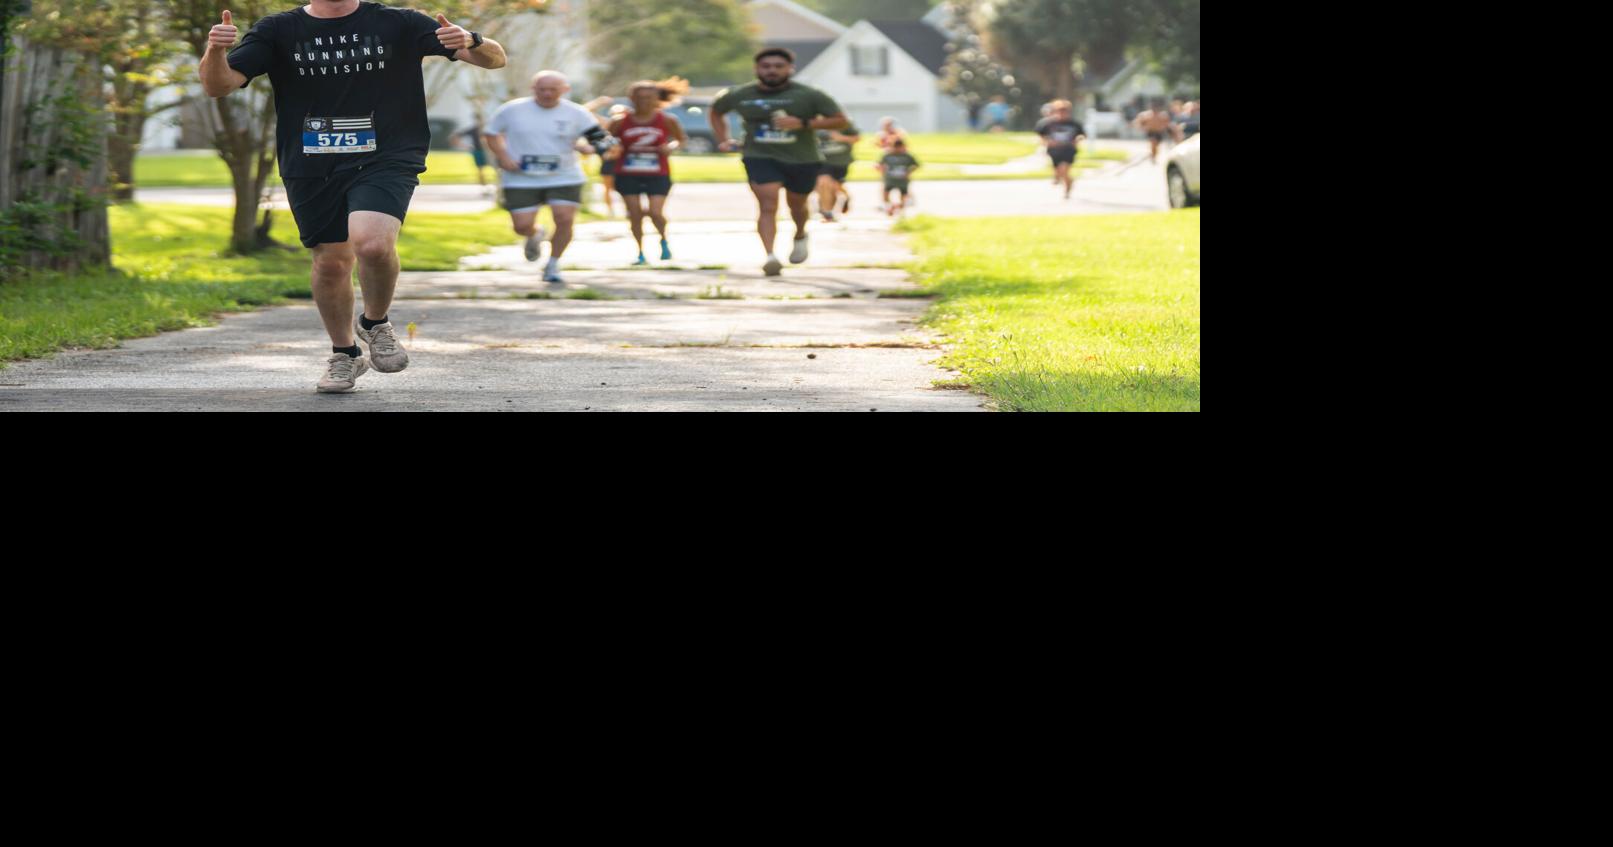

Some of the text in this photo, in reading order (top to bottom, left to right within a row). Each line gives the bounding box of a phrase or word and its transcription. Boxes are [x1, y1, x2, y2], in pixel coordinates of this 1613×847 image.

[315, 33, 359, 46] NIKE
[294, 46, 384, 62] RUNNING
[299, 61, 385, 76] DIVISION
[317, 132, 358, 146] 575
